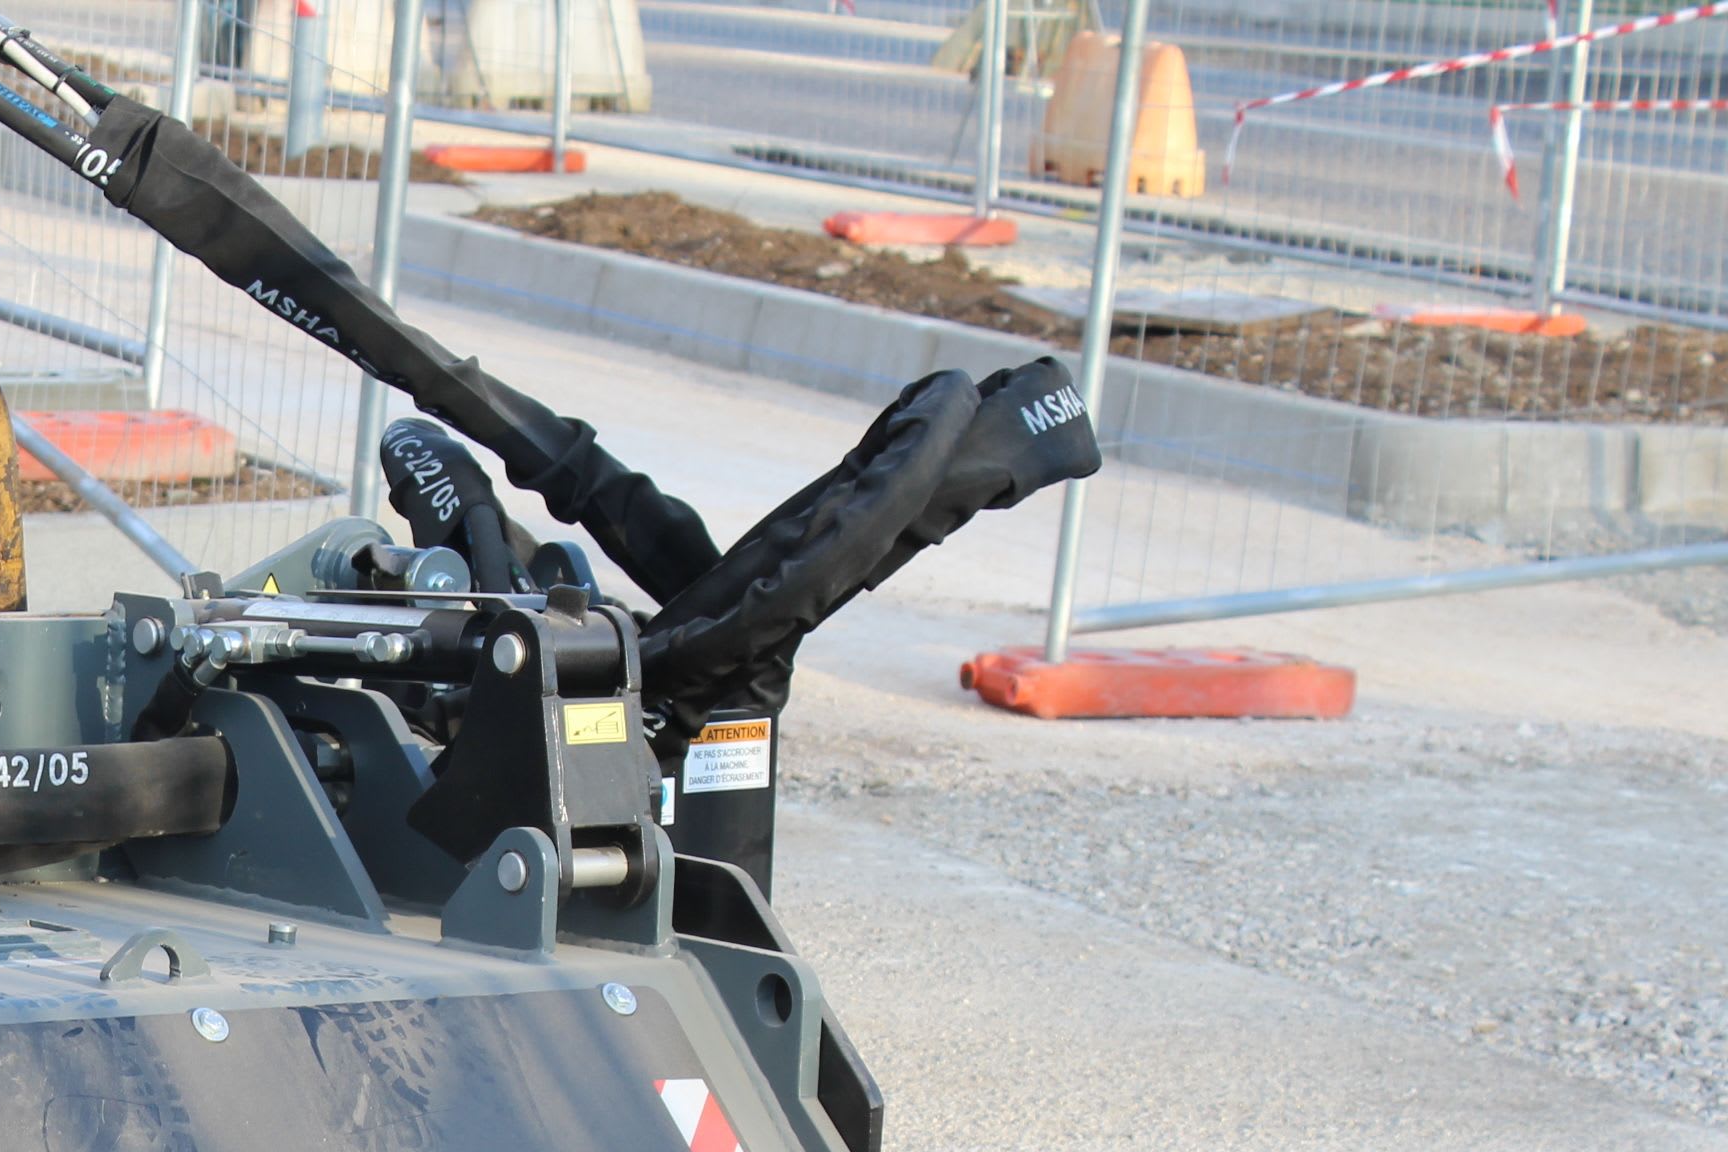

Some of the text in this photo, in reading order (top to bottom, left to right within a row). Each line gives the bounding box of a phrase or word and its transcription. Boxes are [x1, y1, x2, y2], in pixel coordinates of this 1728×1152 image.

[245, 279, 340, 344] MSHA
[1020, 384, 1086, 435] MSHA
[389, 434, 461, 522] IC-22/05
[706, 725, 766, 741] ATTENTION
[694, 750, 703, 760] NE
[689, 775, 714, 786] DANGER
